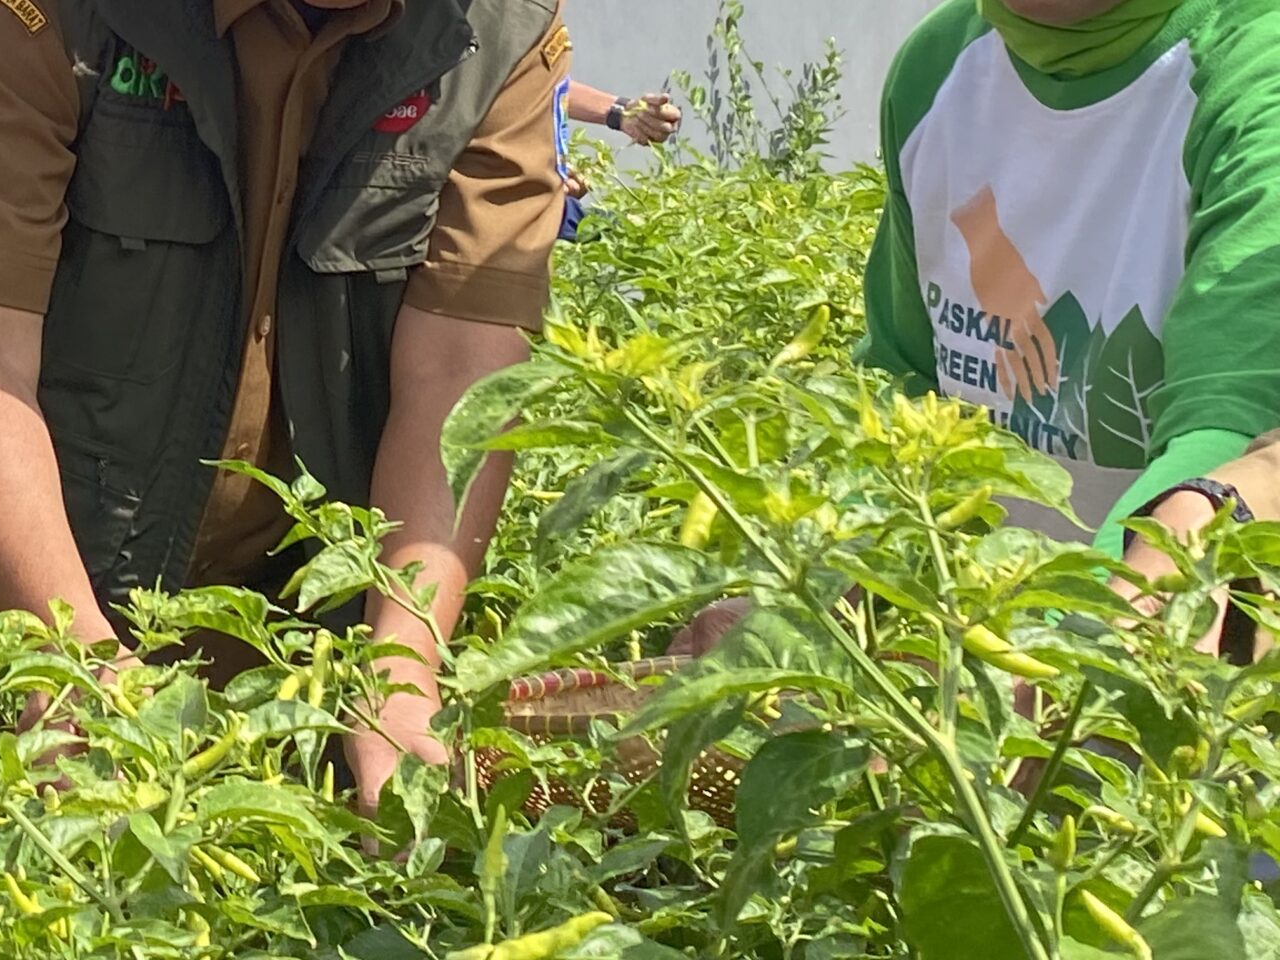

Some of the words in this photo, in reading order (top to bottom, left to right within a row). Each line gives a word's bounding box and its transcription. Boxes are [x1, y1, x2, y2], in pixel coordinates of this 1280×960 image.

[14, 0, 44, 30] BARAT
[927, 281, 1015, 351] PASKAL
[935, 343, 997, 393] REEN
